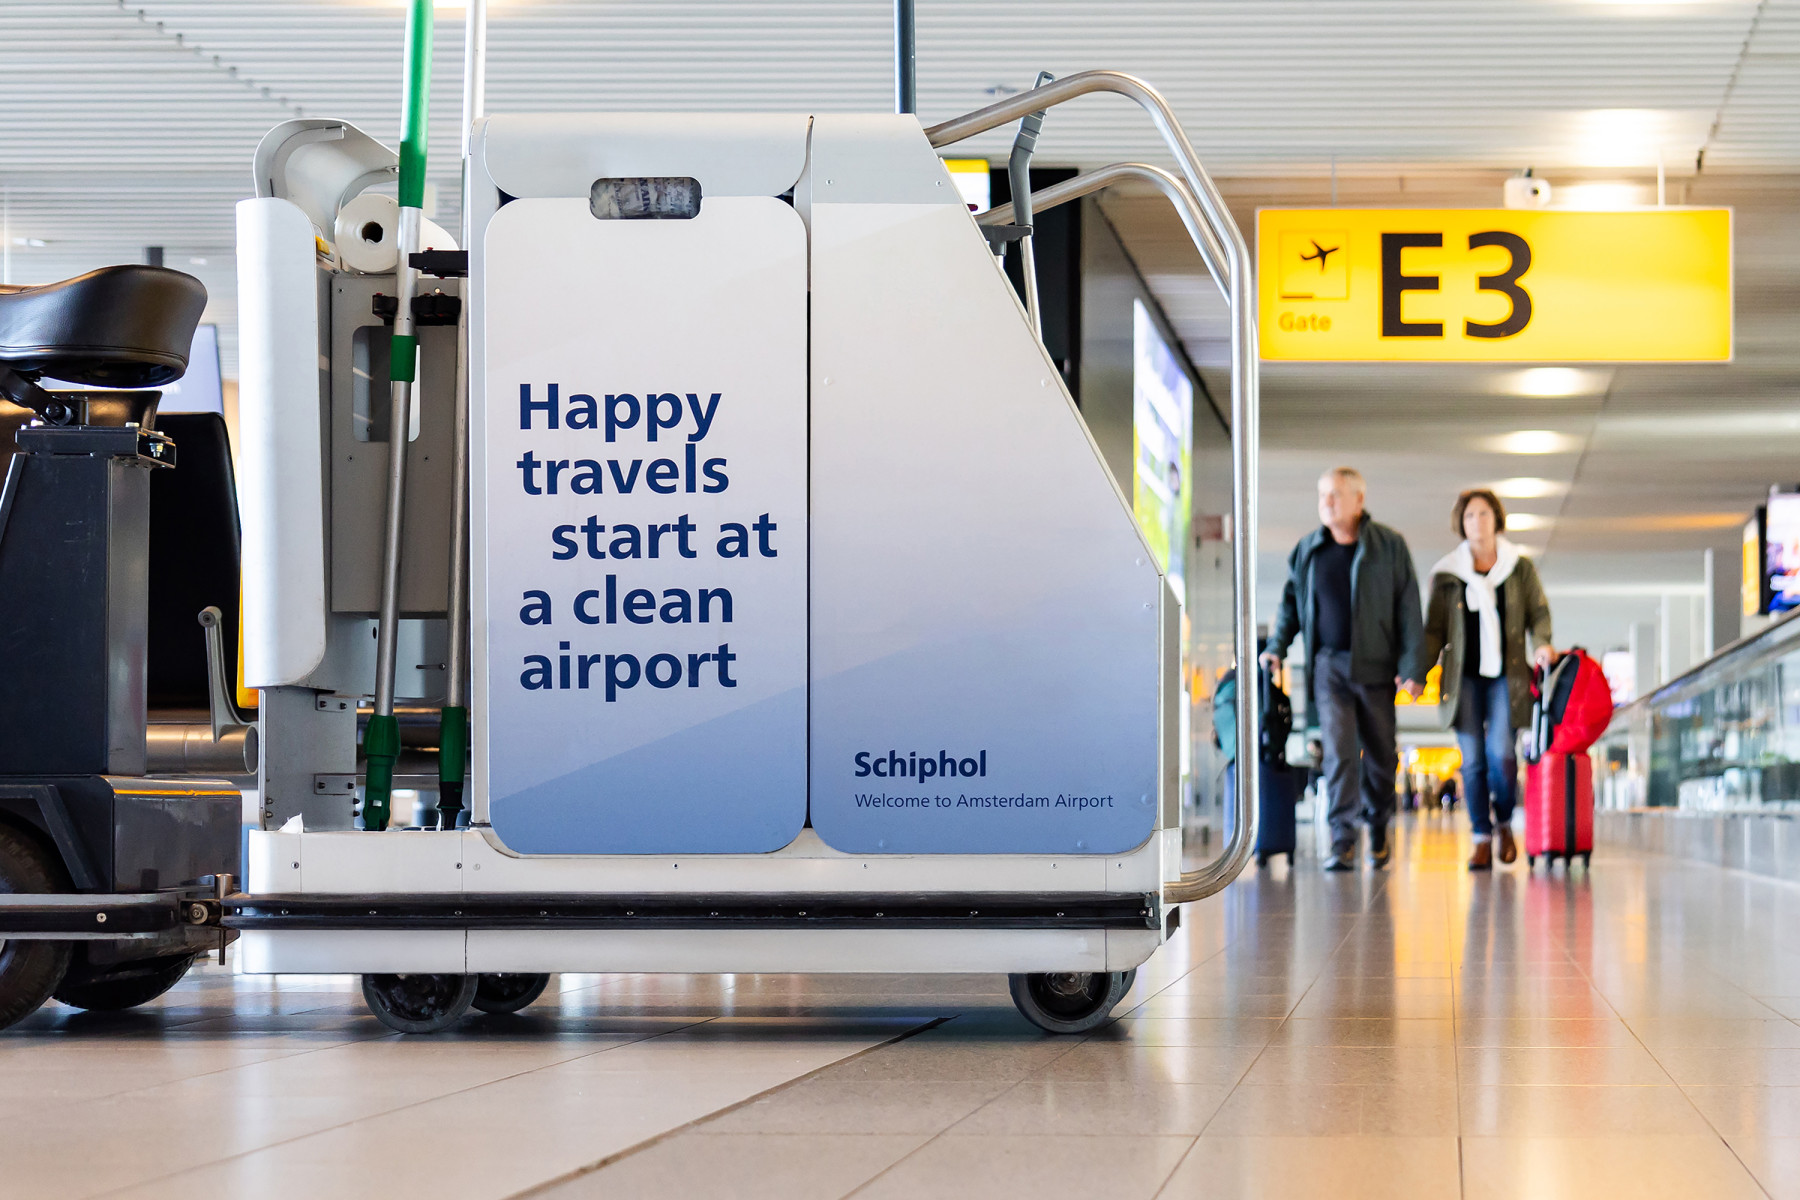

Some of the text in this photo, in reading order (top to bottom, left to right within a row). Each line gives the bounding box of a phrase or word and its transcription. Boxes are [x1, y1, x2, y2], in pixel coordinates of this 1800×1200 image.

[1381, 231, 1533, 338] E3
[1279, 311, 1331, 332] Gate
[519, 383, 722, 443] Happy
[516, 443, 729, 495] travels
[551, 512, 778, 560] start at
[519, 574, 733, 625] a clean
[519, 640, 738, 703] airport
[854, 749, 987, 784] Schiphol
[854, 793, 1114, 812] Welcome to Amsterdam Airport
